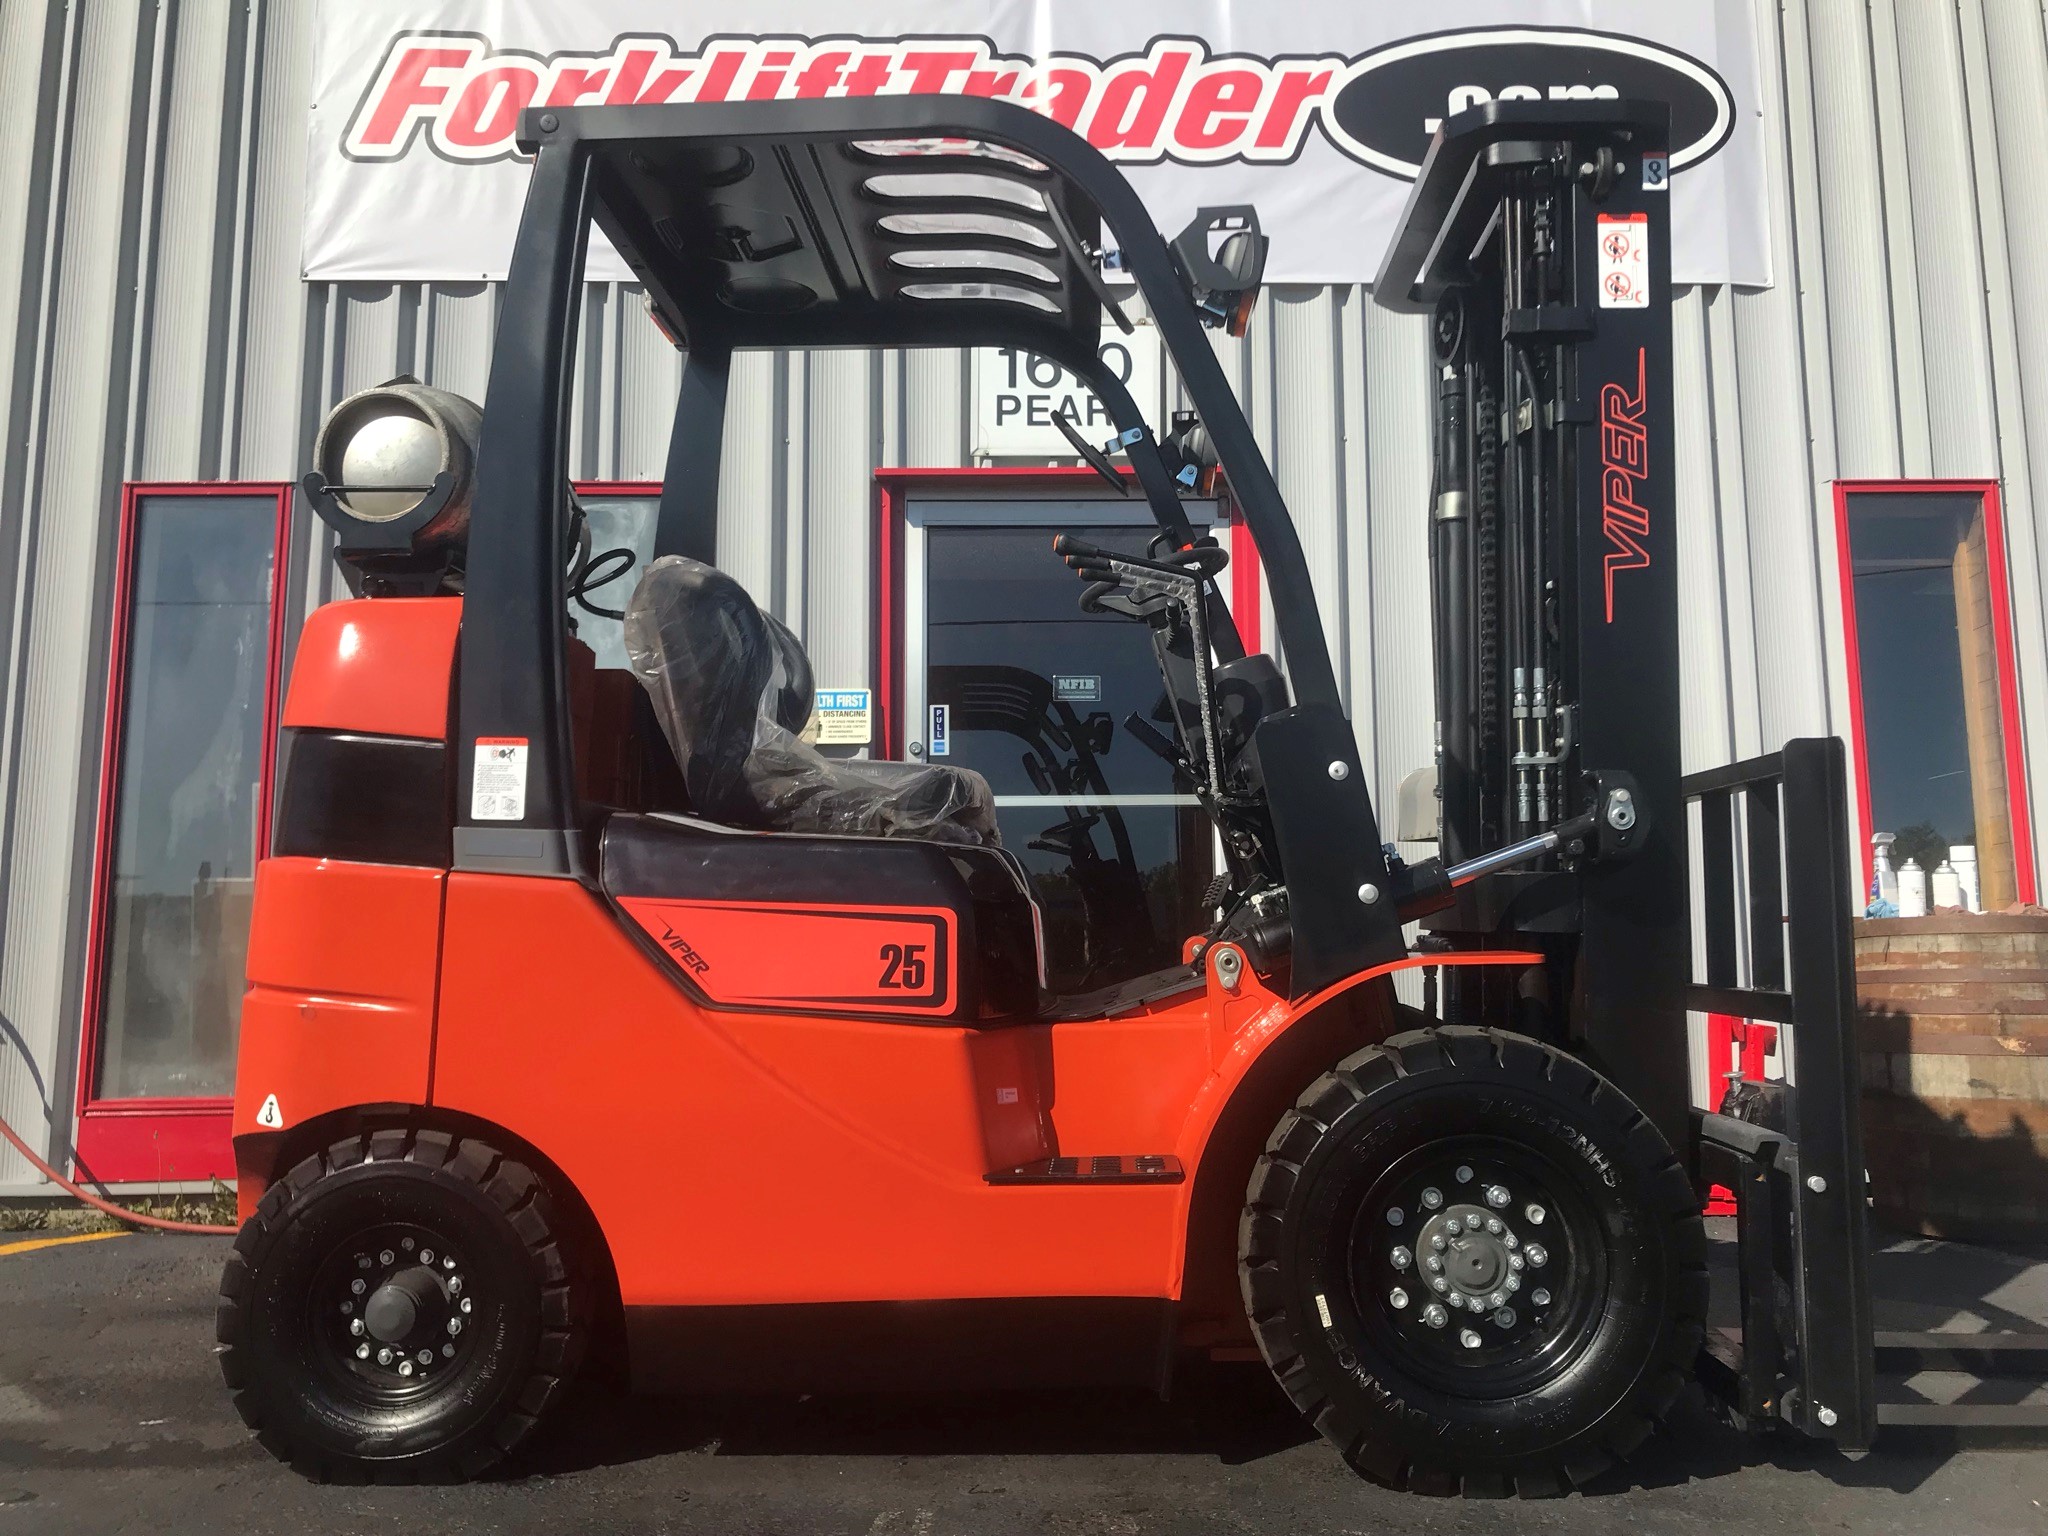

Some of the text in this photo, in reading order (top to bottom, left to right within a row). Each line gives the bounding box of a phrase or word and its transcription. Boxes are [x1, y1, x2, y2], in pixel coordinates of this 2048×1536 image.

[998, 342, 1133, 389] 160
[1600, 346, 1650, 624] VIPER
[817, 693, 865, 708] LTH FIRST
[1058, 678, 1095, 690] NFIB
[823, 710, 867, 718] DISTANCING
[935, 709, 943, 738] PULL
[658, 916, 711, 984] VIPER
[878, 943, 927, 990] 25
